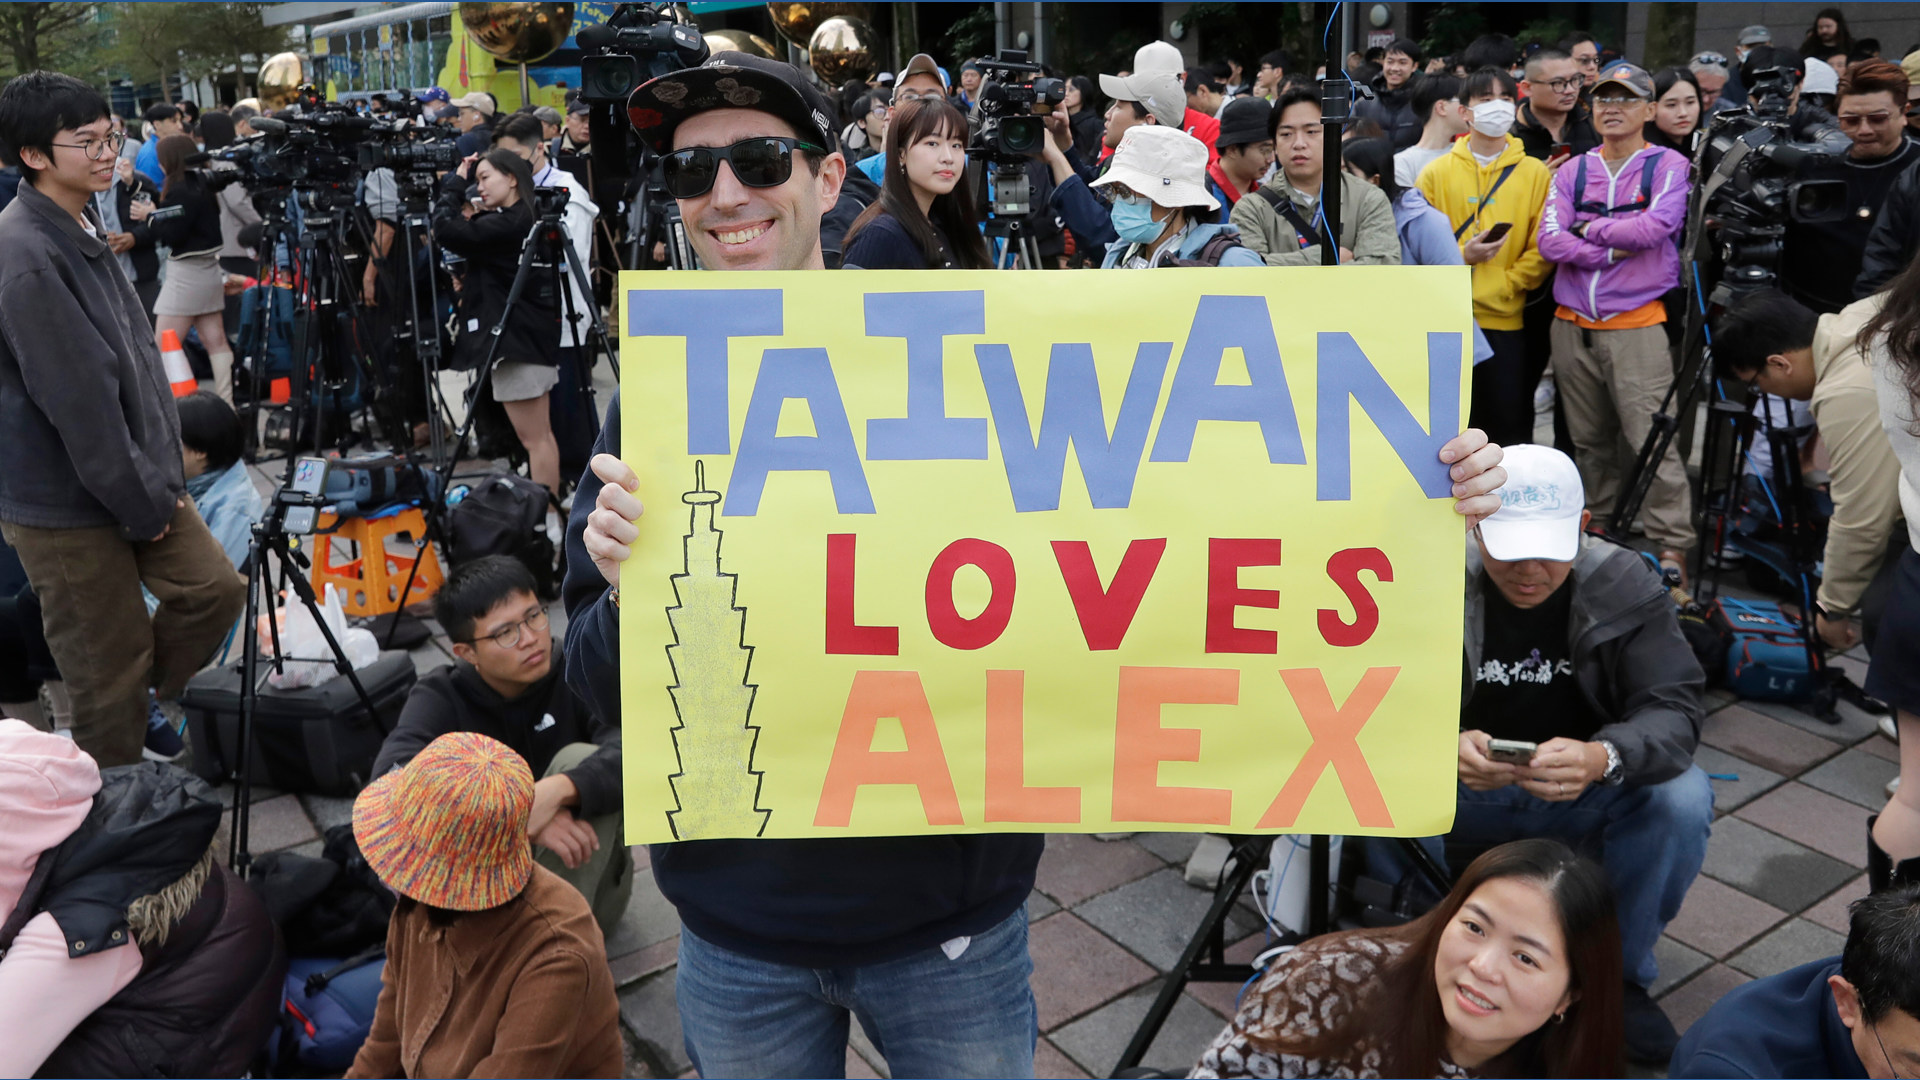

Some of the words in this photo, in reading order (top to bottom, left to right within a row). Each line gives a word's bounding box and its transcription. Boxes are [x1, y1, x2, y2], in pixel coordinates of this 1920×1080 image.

[628, 289, 1462, 516] TAIWAN
[825, 533, 1395, 656] LOVES
[815, 666, 1400, 829] ALEX
